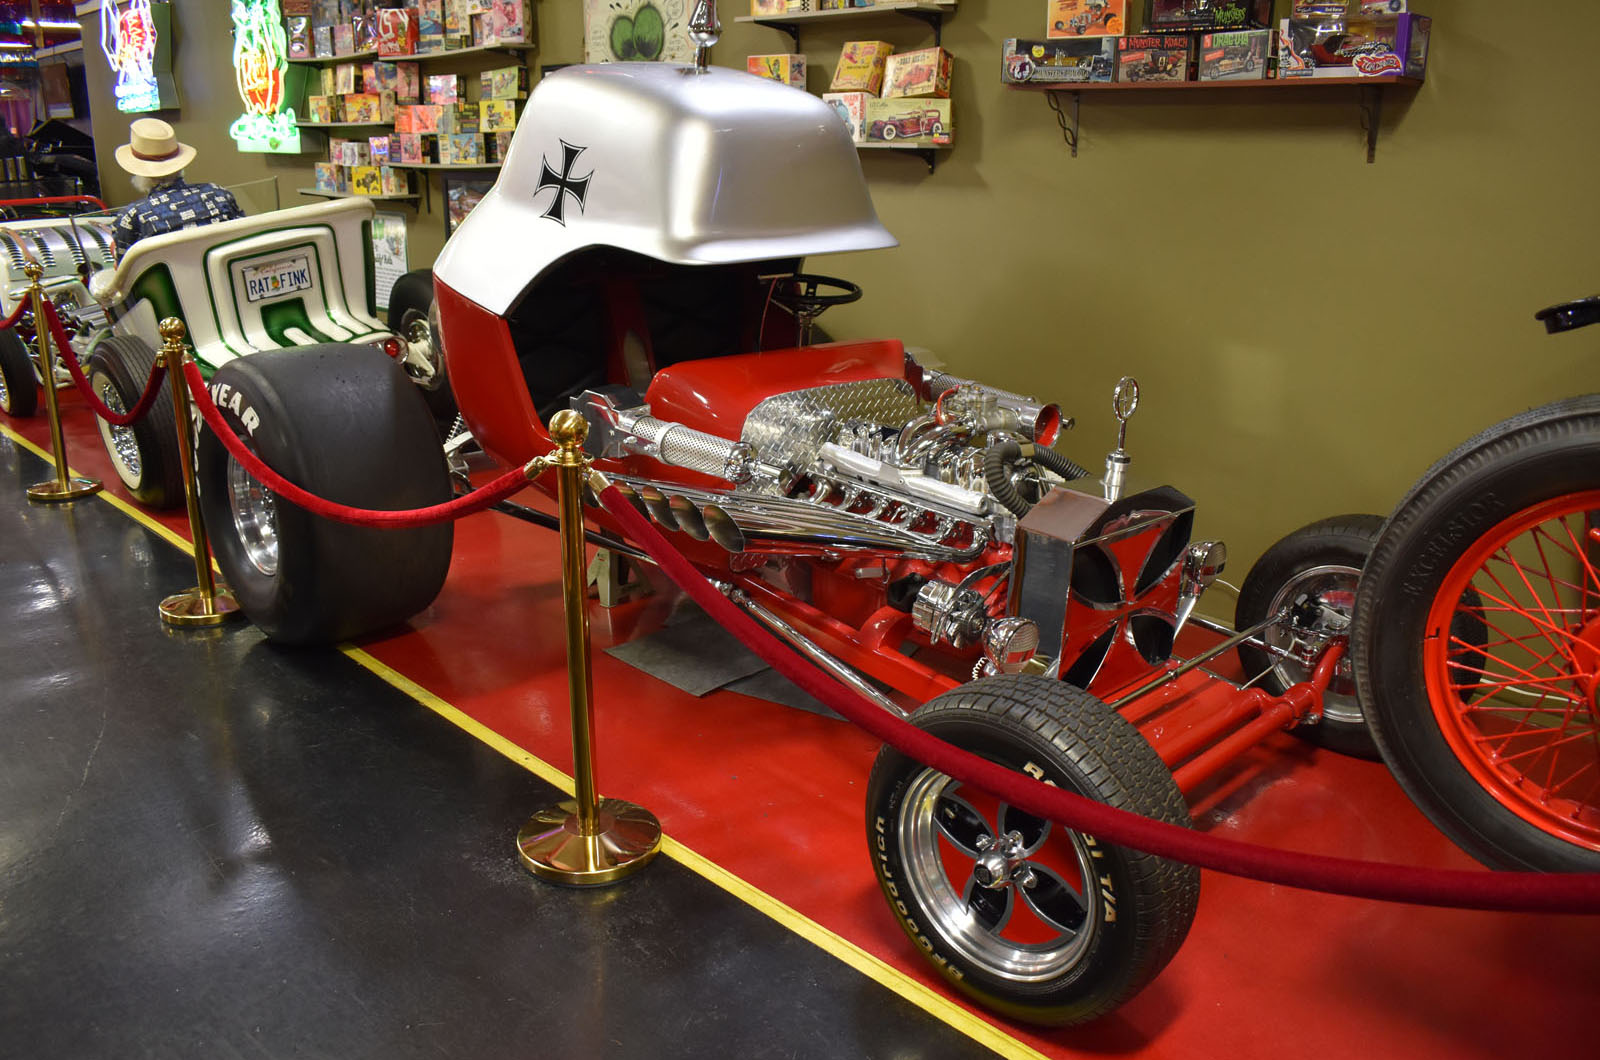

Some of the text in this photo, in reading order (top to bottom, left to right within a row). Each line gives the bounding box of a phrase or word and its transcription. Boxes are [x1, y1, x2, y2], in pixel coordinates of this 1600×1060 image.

[249, 268, 308, 296] RAT FINK
[1100, 873, 1117, 923] T/A
